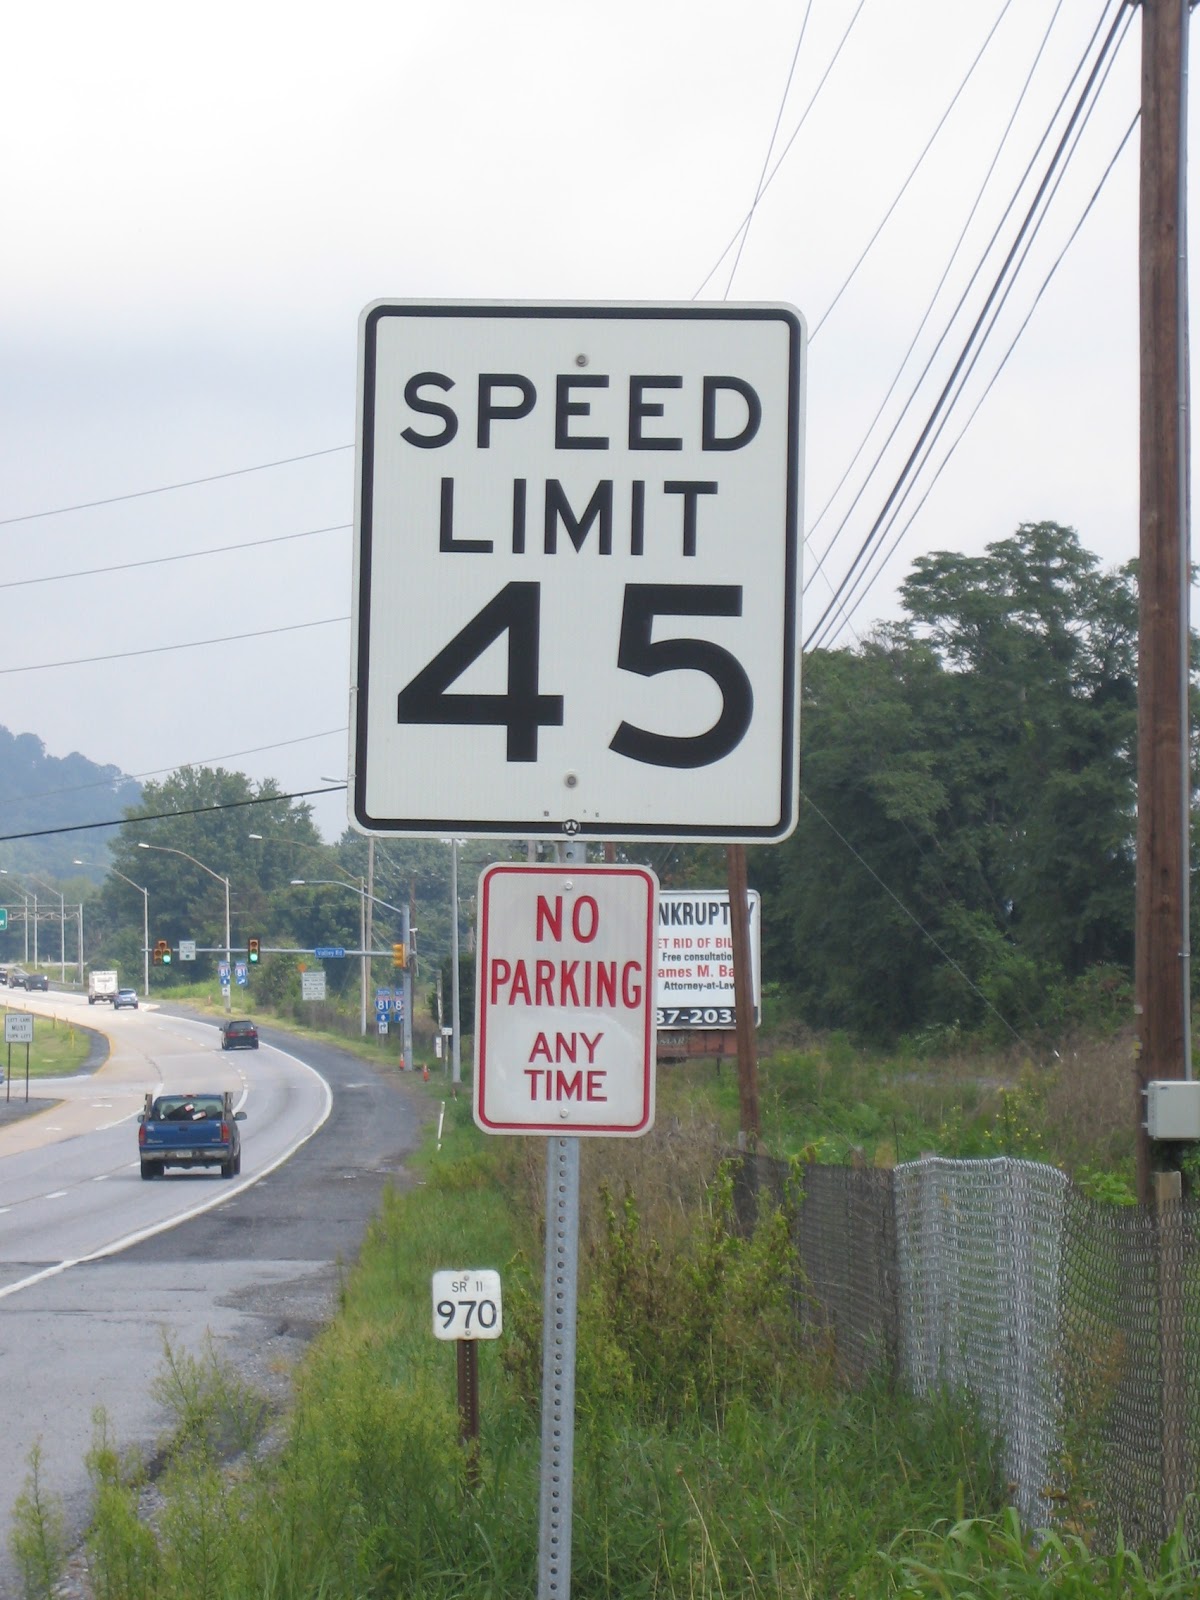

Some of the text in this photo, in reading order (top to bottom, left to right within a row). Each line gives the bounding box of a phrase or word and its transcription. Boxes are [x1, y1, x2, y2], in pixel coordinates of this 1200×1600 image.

[400, 371, 762, 452] SPEED
[439, 477, 719, 557] LIMIT
[397, 581, 754, 769] 45
[535, 894, 599, 944] NO
[662, 952, 682, 962] Free
[673, 938, 693, 949] RID
[697, 938, 711, 949] OF
[491, 959, 642, 1009] PARKING
[697, 964, 714, 978] M.
[377, 1000, 389, 1010] 81
[528, 1032, 604, 1063] ANY
[524, 1069, 607, 1101] TIME
[452, 1281, 467, 1293] SR
[437, 1300, 497, 1329] 970
